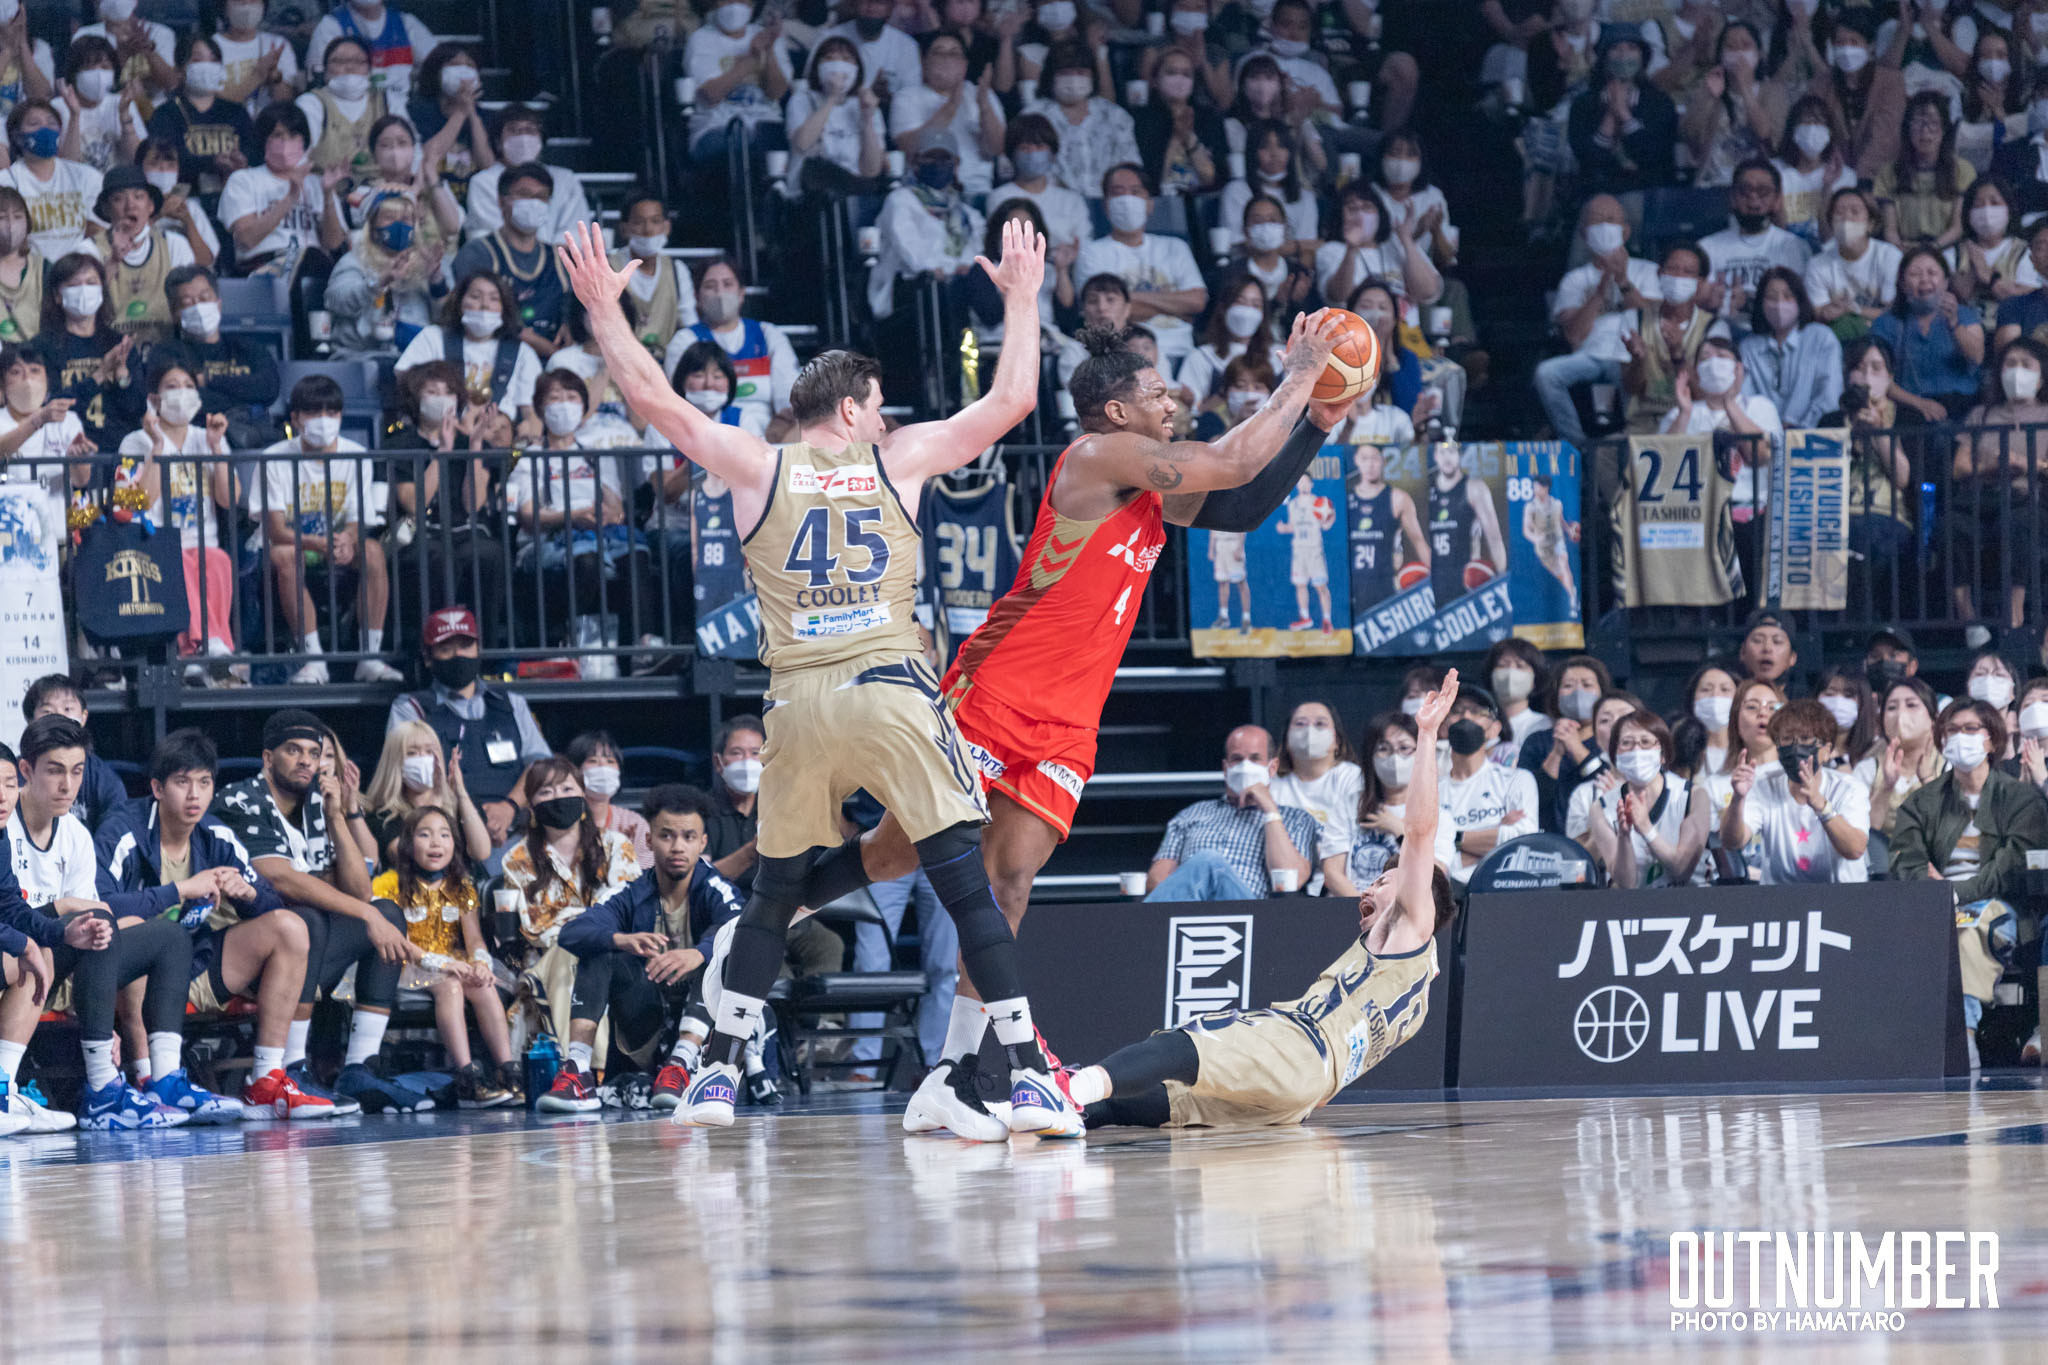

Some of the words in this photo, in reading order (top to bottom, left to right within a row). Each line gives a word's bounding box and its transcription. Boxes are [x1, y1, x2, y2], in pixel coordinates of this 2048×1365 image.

[1790, 433, 1844, 460] 4
[1505, 454, 1575, 476] MAKI
[1638, 448, 1705, 502] 24
[1507, 477, 1533, 501] 88
[1641, 507, 1701, 521] TASHIRO
[1817, 466, 1843, 551] RYUICHI
[1787, 466, 1814, 585] KISHIMOTO
[703, 543, 725, 566] 88
[783, 506, 892, 589] 45
[936, 521, 998, 591] 34
[25, 592, 33, 607] 7
[797, 584, 881, 608] COOLEY
[1113, 584, 1133, 625] 4
[4, 613, 56, 622] DURHAM
[823, 608, 874, 624] FamilyMart
[1353, 586, 1436, 654] TASHIRO
[23, 635, 40, 649] 14
[6, 656, 57, 665] KISHIMOTO
[1493, 879, 1538, 889] OKINAWA
[1558, 911, 1851, 979] バスケット
[1661, 989, 1821, 1052] LIVE
[704, 1085, 735, 1104] NIKE
